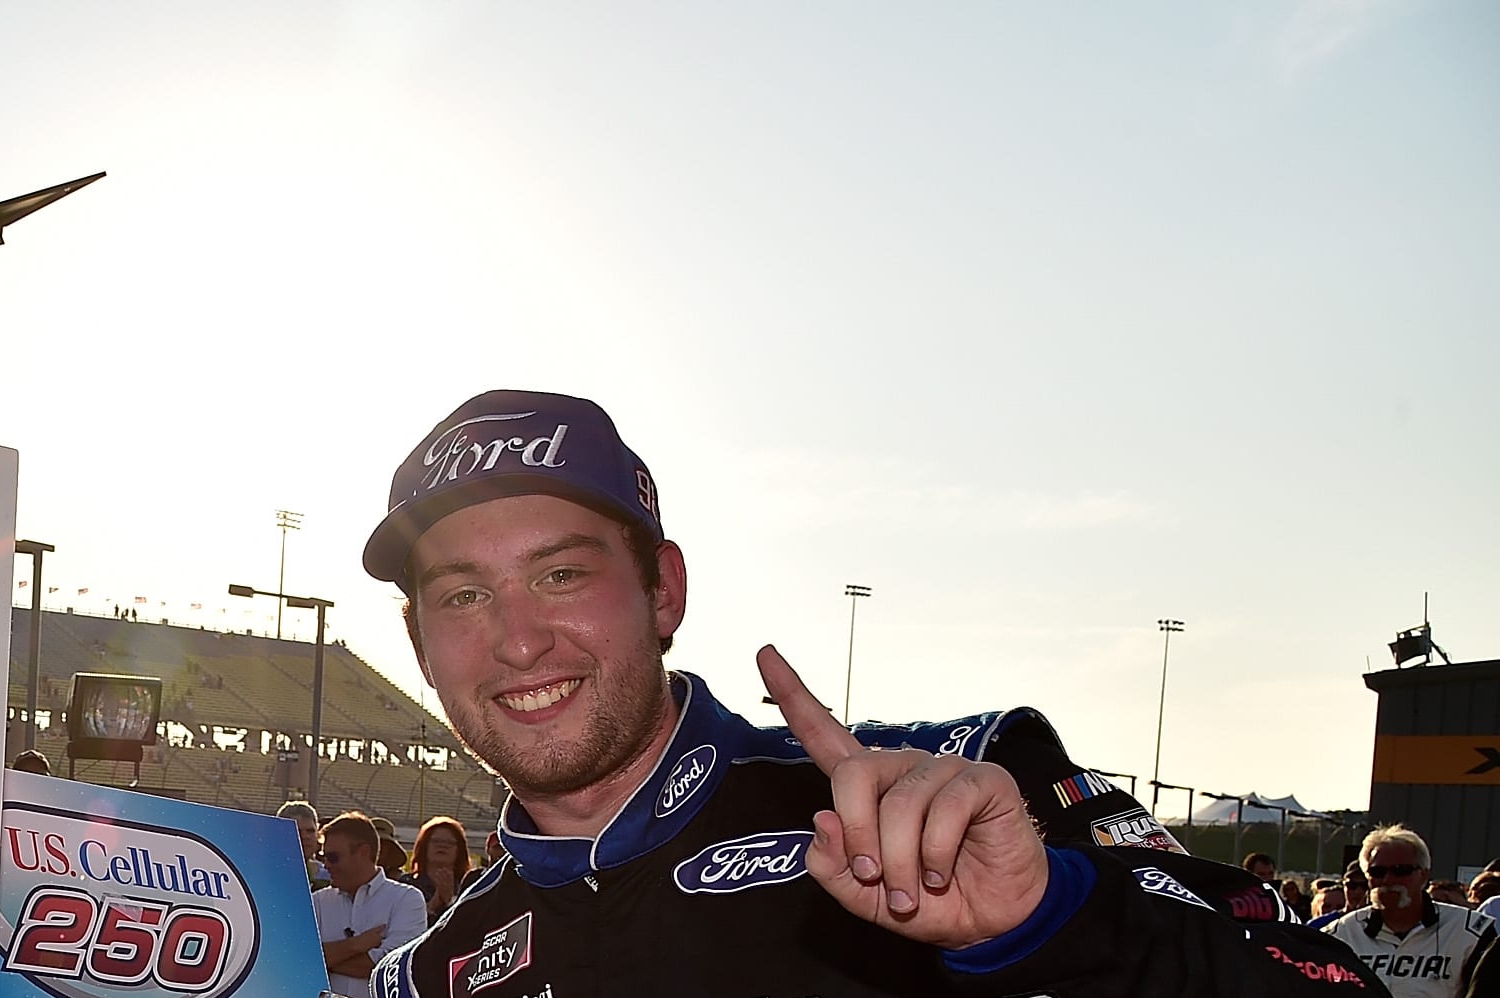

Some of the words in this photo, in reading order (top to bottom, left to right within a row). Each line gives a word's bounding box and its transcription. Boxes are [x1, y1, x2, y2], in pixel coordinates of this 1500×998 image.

[420, 411, 568, 490] Ford
[662, 758, 704, 808] Ford
[79, 840, 231, 900] Cellular
[701, 840, 801, 883] Ford
[2, 884, 234, 994] 250
